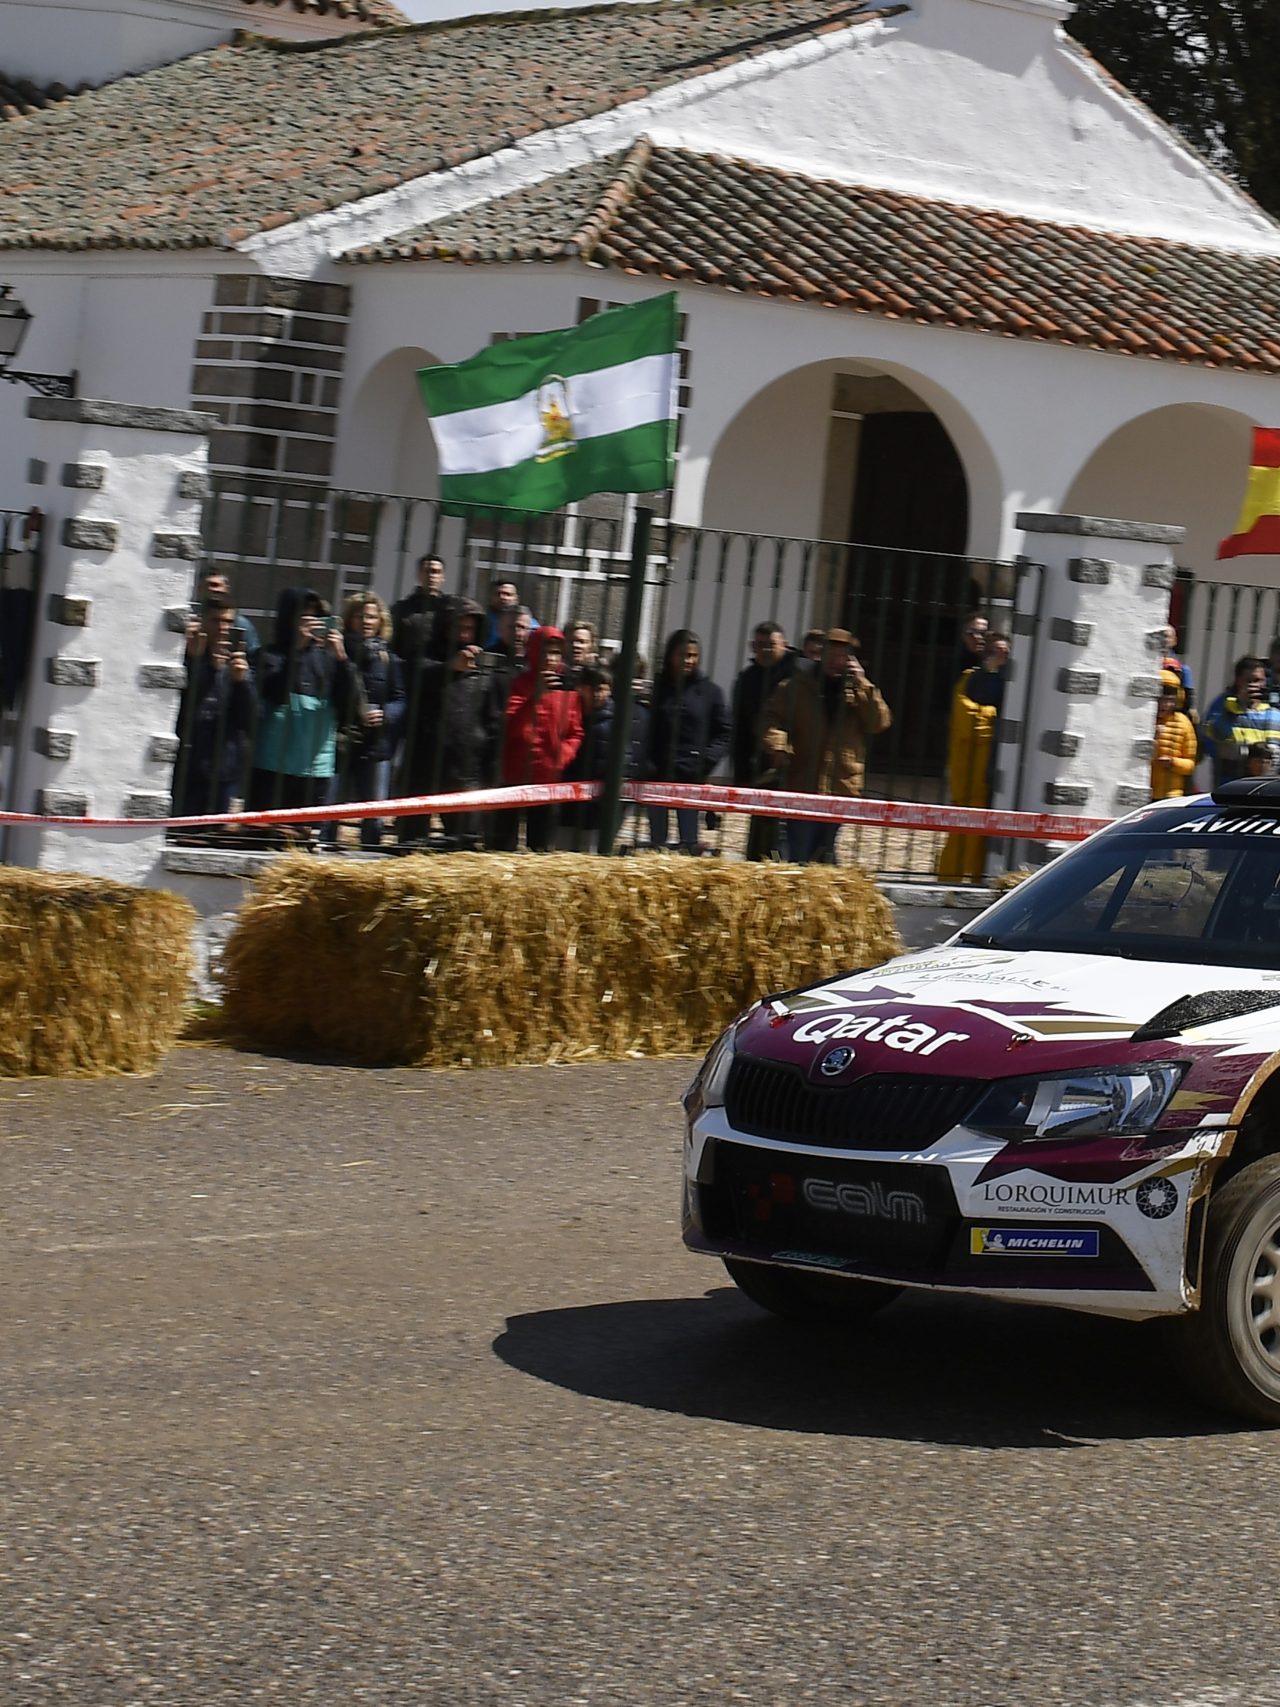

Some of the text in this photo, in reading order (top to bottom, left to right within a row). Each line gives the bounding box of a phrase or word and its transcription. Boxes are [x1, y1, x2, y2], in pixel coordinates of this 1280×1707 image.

[792, 1013, 971, 1056] Qatar
[983, 1183, 1132, 1207] LORQUIMUR
[997, 1205, 1047, 1215] RESTAURACIÓN
[1053, 1206, 1107, 1216] CONSTRUCCIÓN
[1006, 1237, 1085, 1249] MICHELIN
